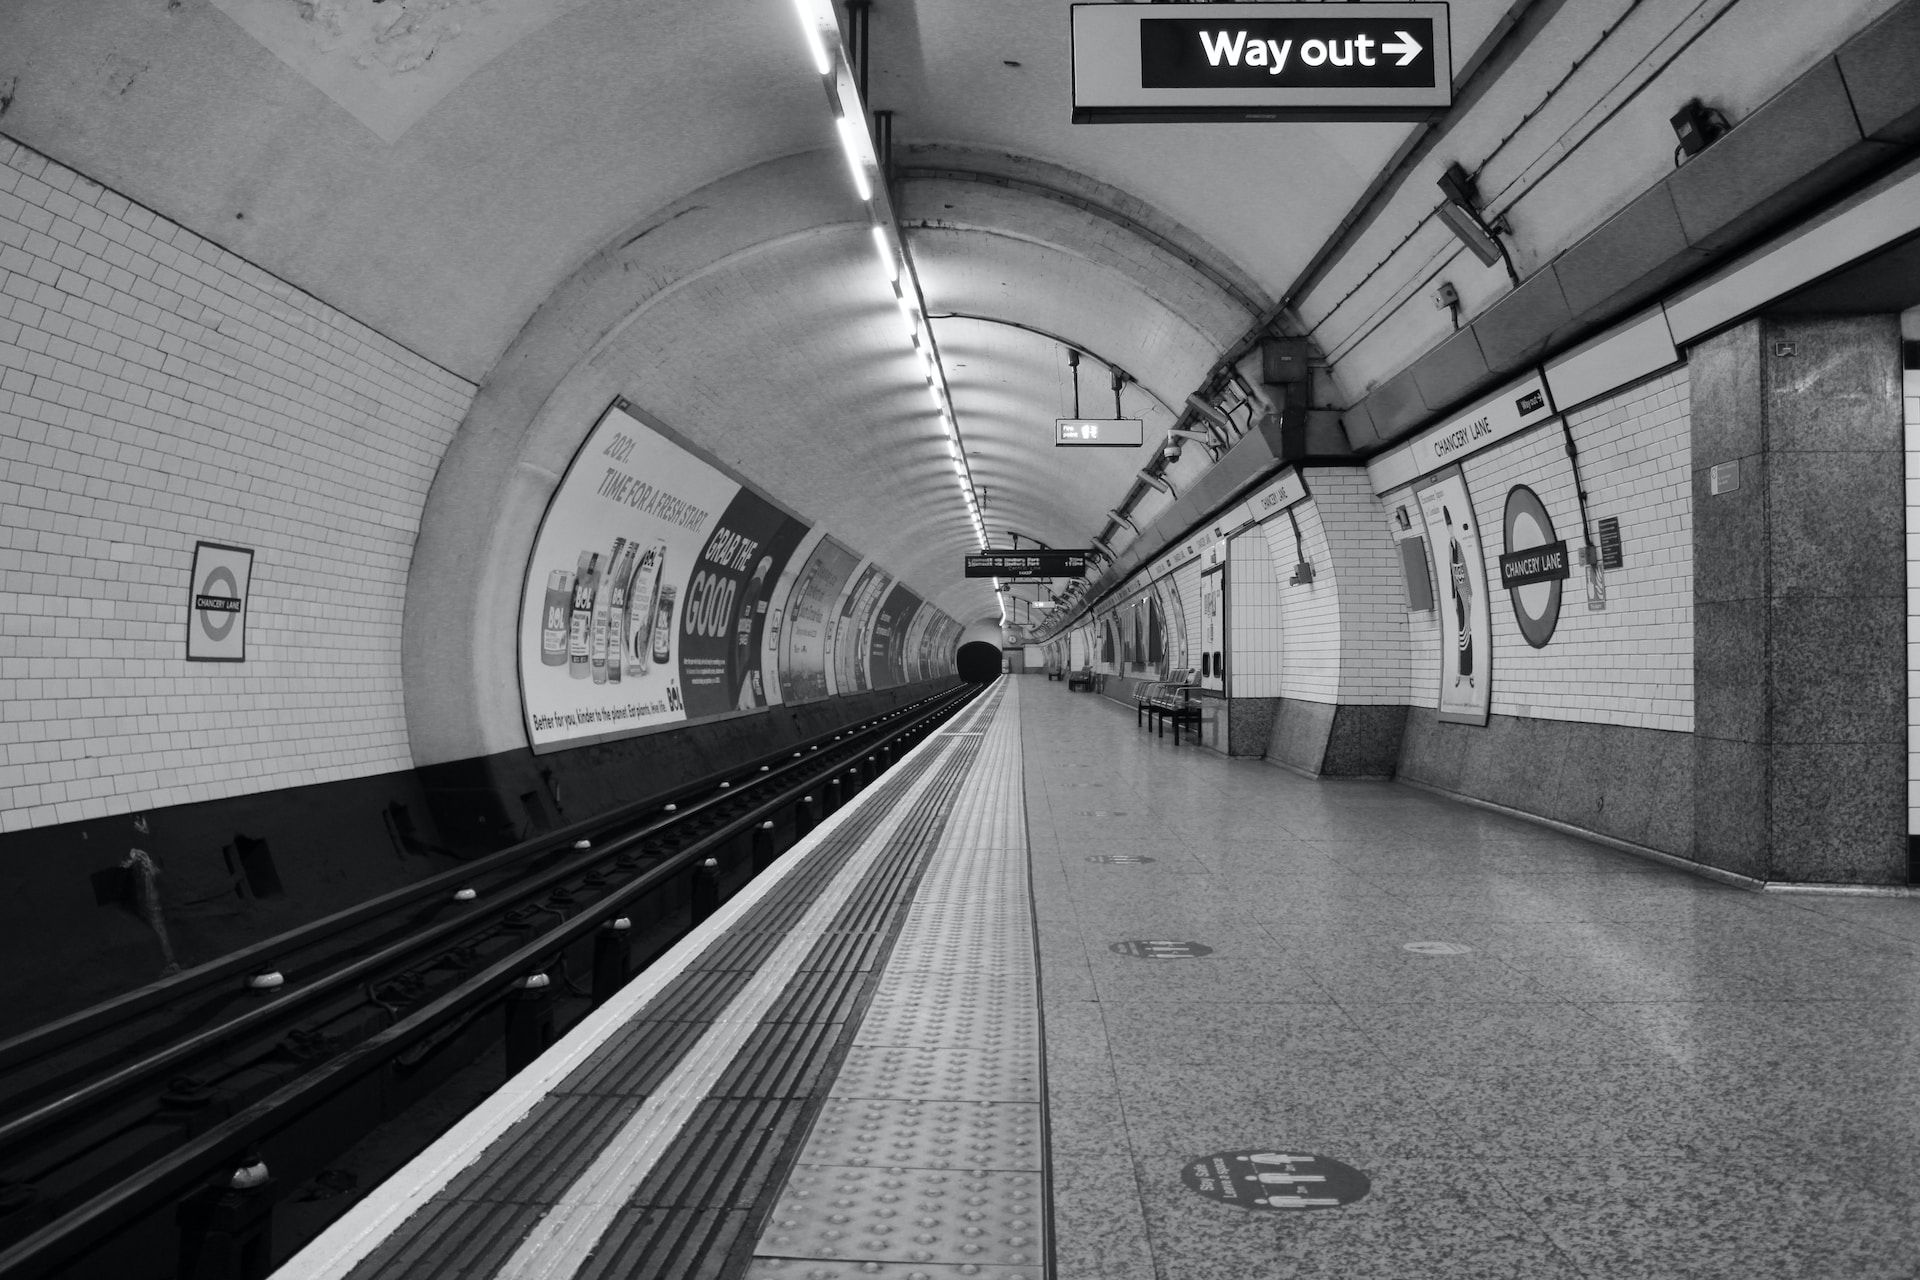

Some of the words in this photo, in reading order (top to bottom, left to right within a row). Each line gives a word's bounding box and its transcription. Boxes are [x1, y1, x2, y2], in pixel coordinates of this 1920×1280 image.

[1199, 30, 1292, 75] Way
[1300, 33, 1376, 67] out
[1434, 427, 1470, 458] CHANCERY
[1469, 416, 1492, 440] LANE
[597, 467, 633, 502] TIME
[623, 479, 653, 510] FOR
[644, 489, 660, 514] A
[652, 492, 687, 525] FRESH
[704, 527, 742, 566] GRAB
[730, 537, 759, 572] THE
[1505, 557, 1540, 578] CHANCERY
[1542, 552, 1562, 571] LANE
[197, 598, 225, 608] CHANCERY
[226, 600, 239, 610] LANE
[575, 586, 592, 609] BOL
[685, 570, 737, 638] GOOD
[548, 606, 564, 629] BOL
[666, 686, 683, 712] BOL
[533, 713, 554, 731] Better
[554, 711, 564, 729] for
[576, 705, 595, 724] kinder
[594, 708, 602, 722] to
[601, 705, 612, 721] the
[1212, 1157, 1230, 1175] space
[1199, 1177, 1215, 1191] Stay
[1220, 1180, 1238, 1198] Leave
